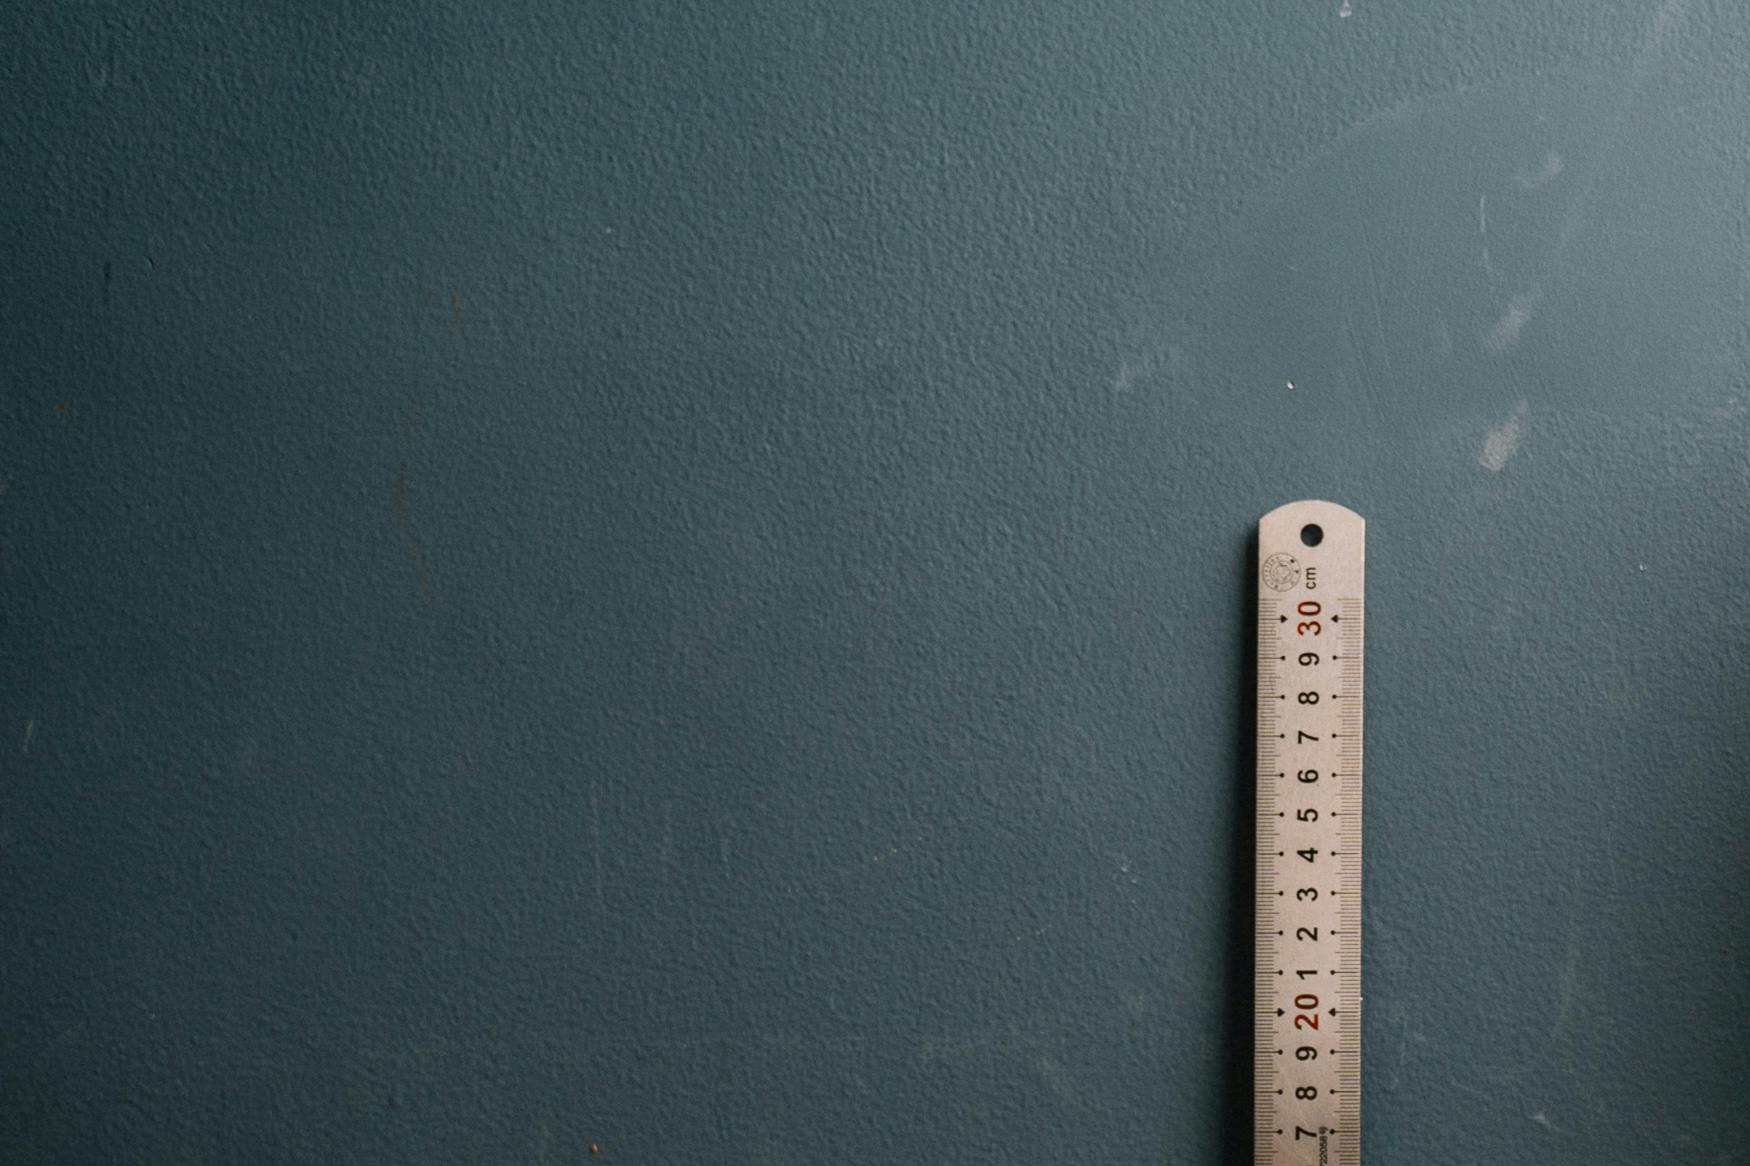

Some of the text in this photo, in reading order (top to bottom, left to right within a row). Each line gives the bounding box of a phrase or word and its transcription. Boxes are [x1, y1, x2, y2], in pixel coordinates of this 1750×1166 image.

[1305, 567, 1317, 590] cm
[1297, 600, 1322, 636] 30
[1298, 652, 1320, 667] 9
[1297, 691, 1320, 705] 8
[1297, 730, 1319, 745] 7
[1297, 769, 1319, 784] 6
[1296, 808, 1319, 823] 5
[1296, 847, 1319, 863] 4
[1296, 887, 1318, 902] 3
[1296, 927, 1318, 942] 2
[1295, 970, 1318, 980] 1
[1294, 993, 1319, 1031] 20
[1295, 1046, 1318, 1061] 9
[1295, 1085, 1318, 1101] 8
[1295, 1125, 1318, 1141] 7
